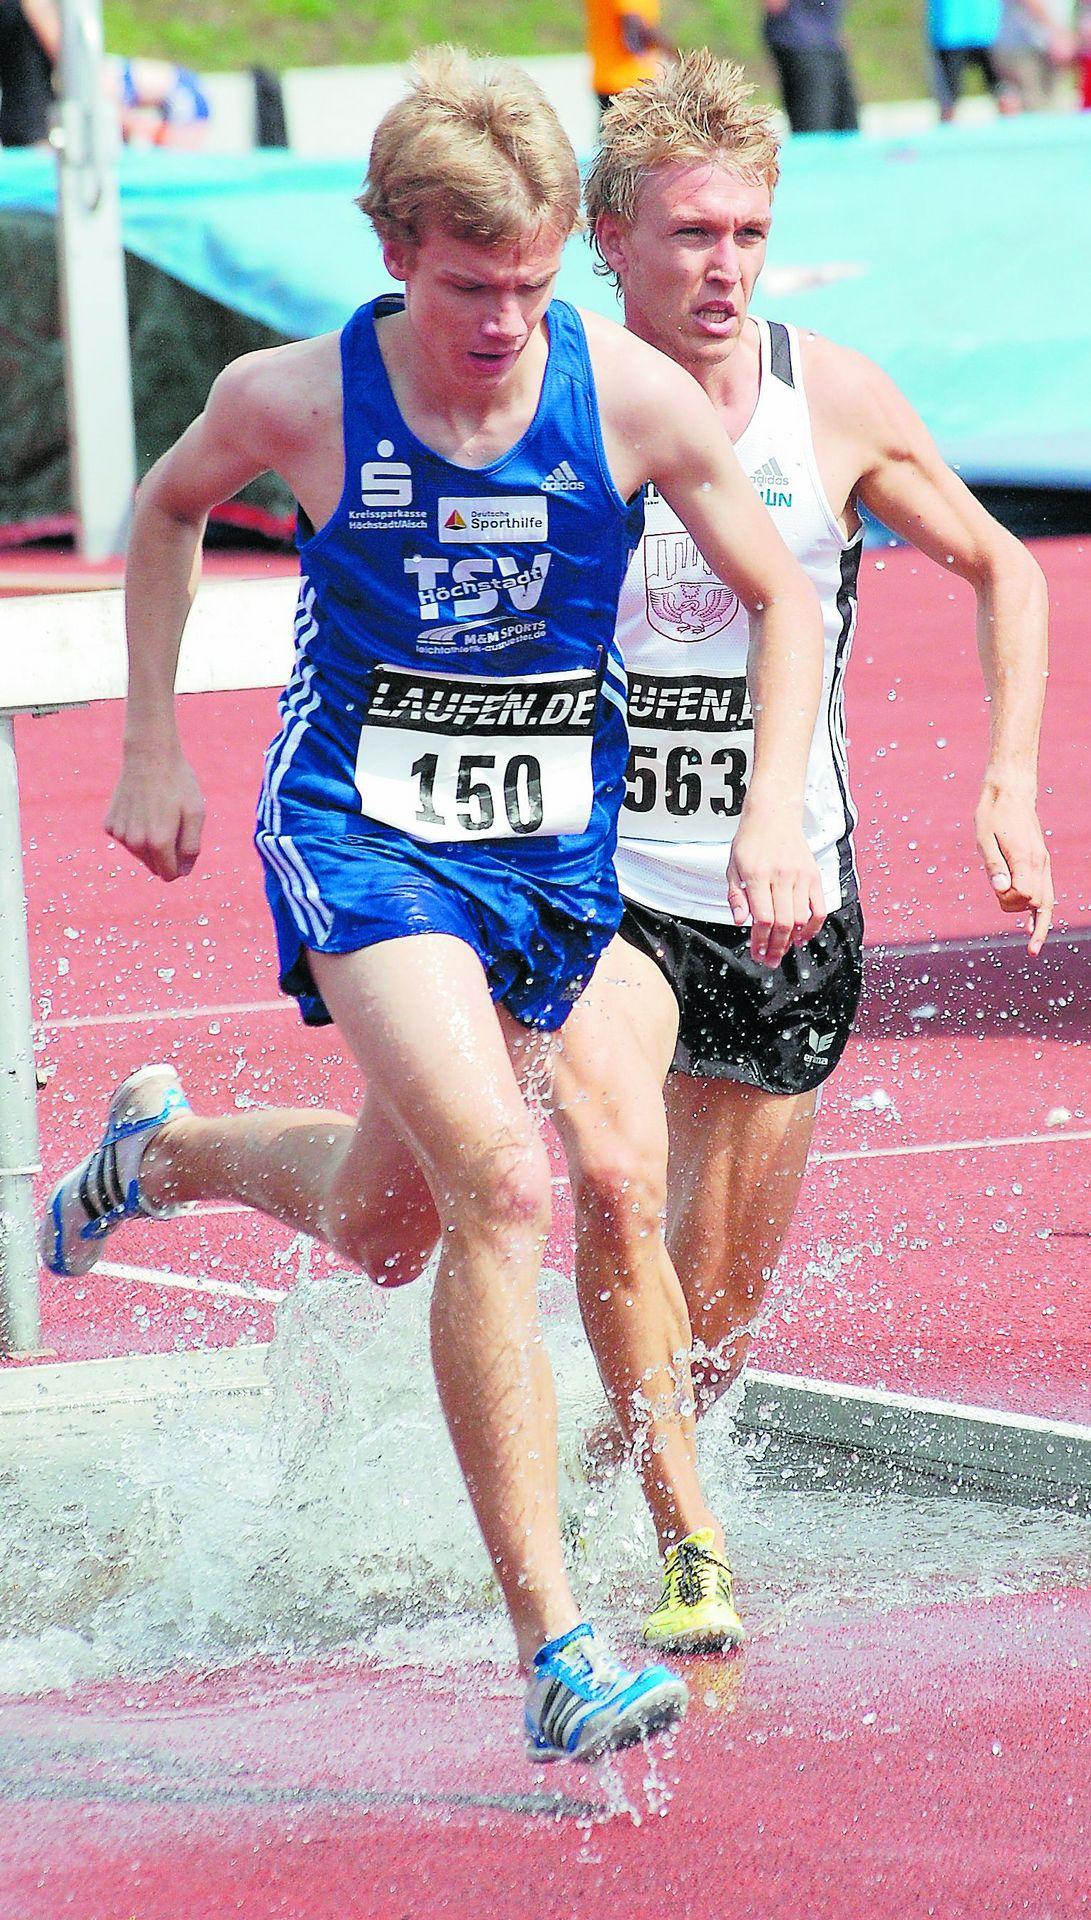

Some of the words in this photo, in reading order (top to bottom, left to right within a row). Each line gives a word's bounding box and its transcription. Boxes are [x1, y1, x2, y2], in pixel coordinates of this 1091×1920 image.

[540, 480, 585, 491] adidas
[348, 509, 428, 520] Kreissparkasse
[348, 520, 428, 530] Höchstadt/Aisch
[471, 517, 543, 531] Sporthilfe
[403, 553, 552, 620] TSV
[417, 568, 543, 606] Höchstadt
[464, 631, 500, 646] M&M
[500, 620, 546, 639] SPORTS
[367, 682, 598, 727] LAUFEN.DE
[410, 752, 544, 835] 150
[622, 745, 748, 817] 563
